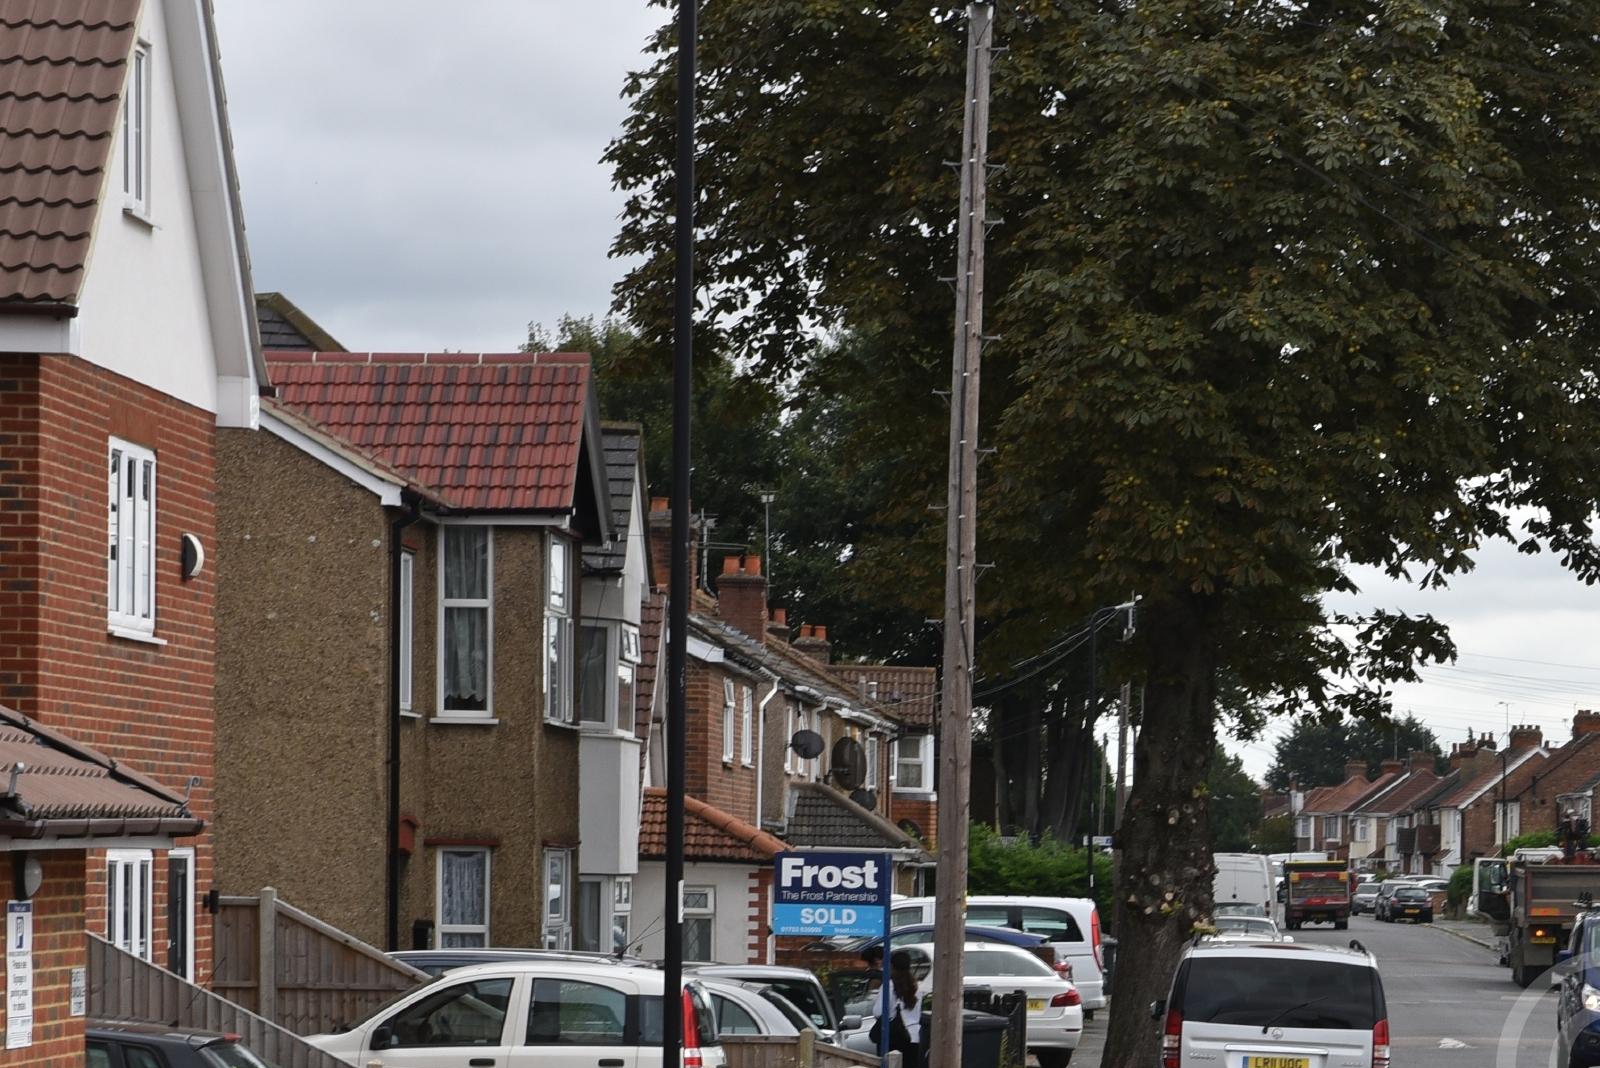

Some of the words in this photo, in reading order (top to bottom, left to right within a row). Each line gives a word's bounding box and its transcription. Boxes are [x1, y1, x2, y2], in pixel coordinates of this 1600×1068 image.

[781, 857, 878, 889] Frost
[782, 890, 799, 901] The
[801, 891, 824, 901] Frost
[825, 891, 878, 903] Partnership
[800, 907, 857, 925] SOLD
